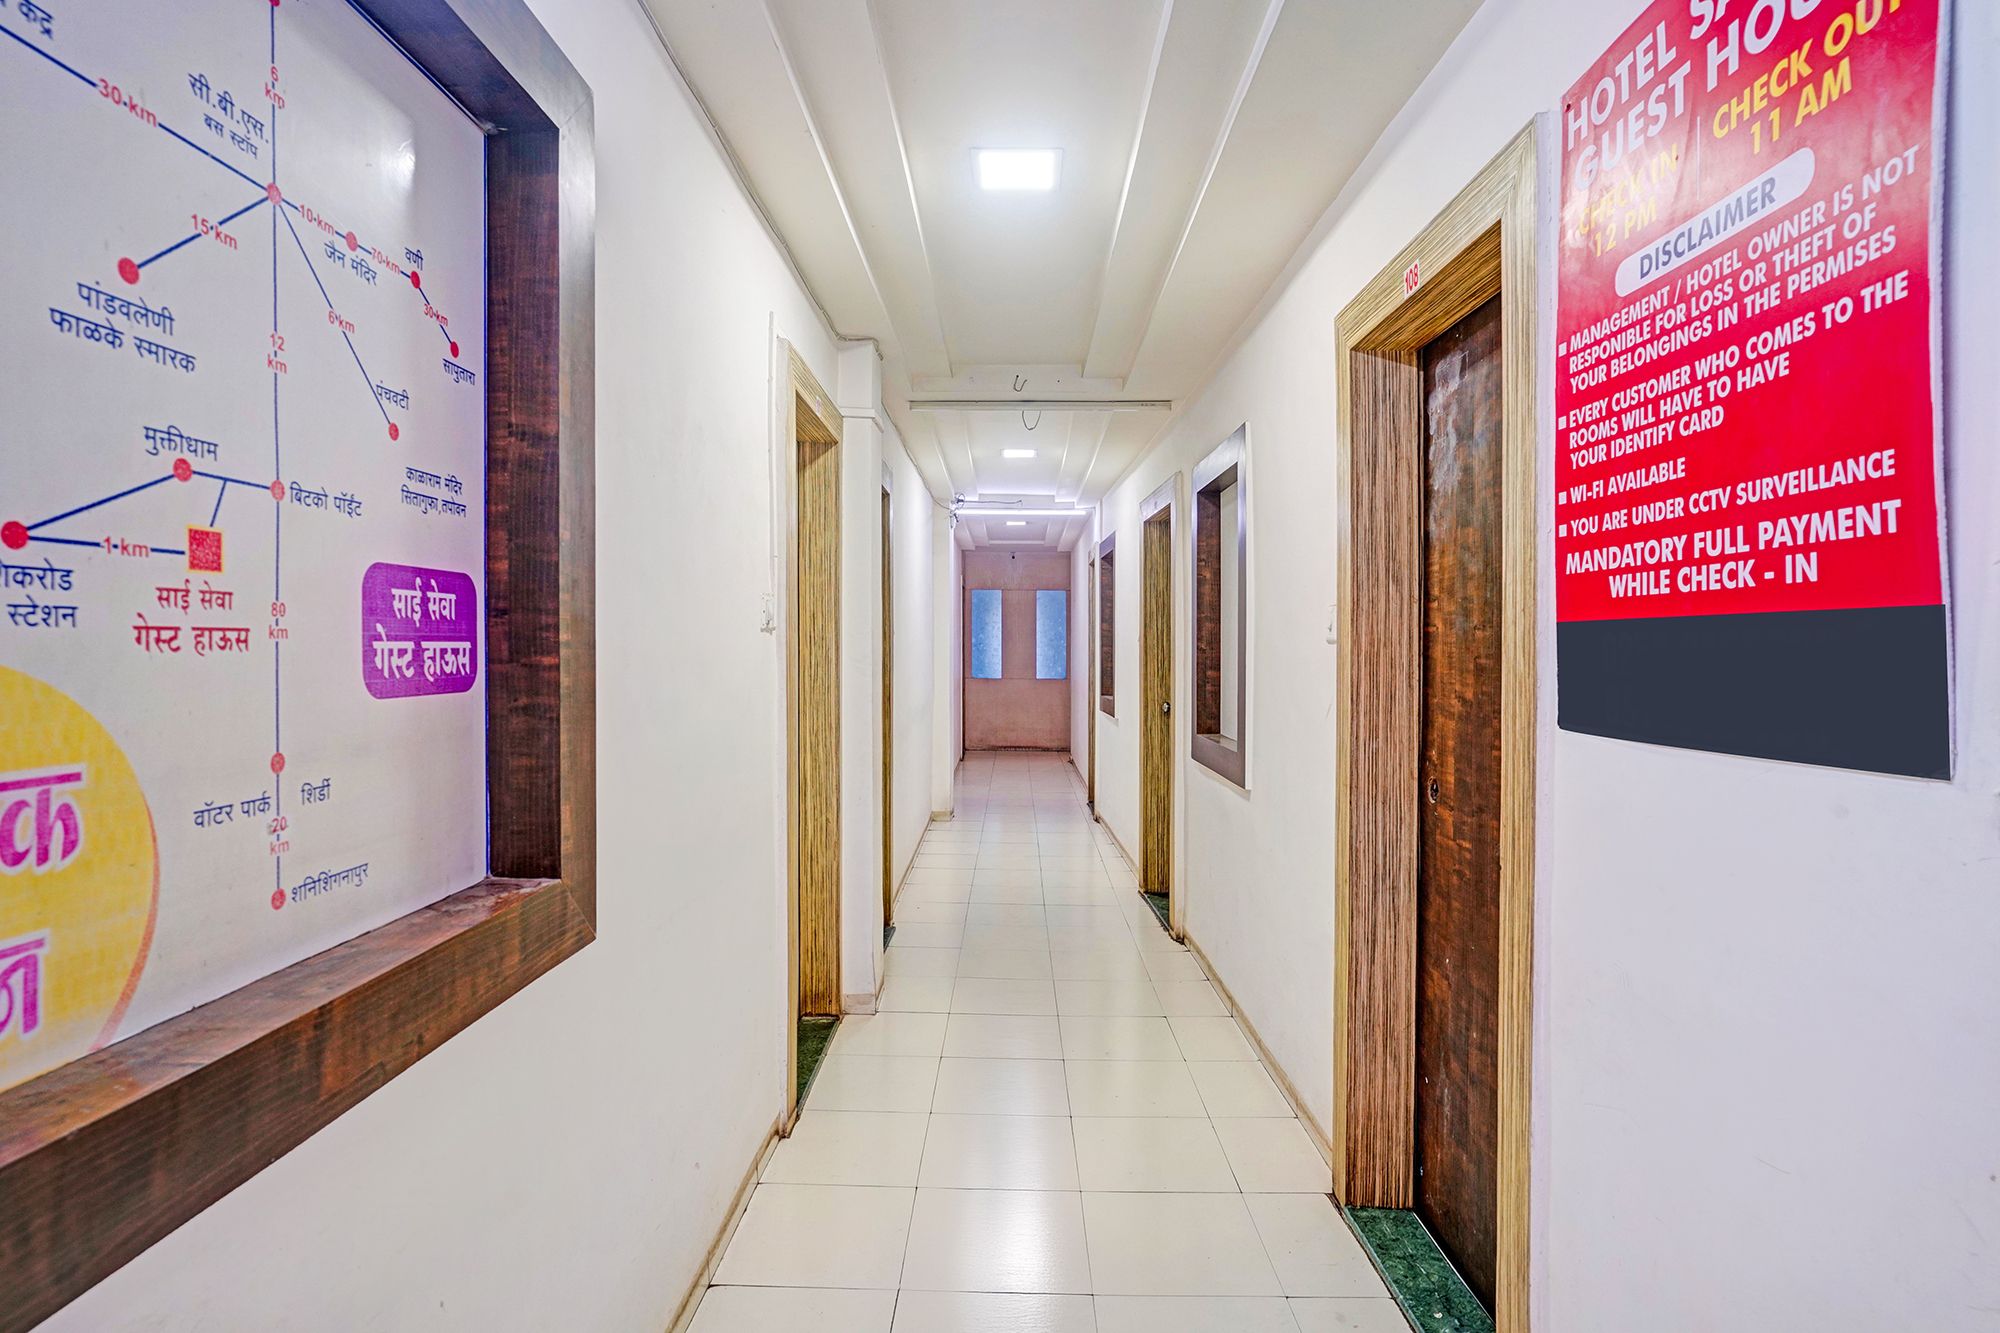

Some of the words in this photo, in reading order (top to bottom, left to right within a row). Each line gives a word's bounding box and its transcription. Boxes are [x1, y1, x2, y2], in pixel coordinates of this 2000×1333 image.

[265, 82, 284, 109] km
[1567, 21, 1676, 152] HOTEL
[1714, 38, 1813, 138] CHECK
[1751, 108, 1780, 154] 11
[1795, 56, 1852, 128] AM
[203, 113, 224, 137] बस
[229, 130, 258, 159] स्टॉप
[1574, 57, 1690, 191] GUEST
[1570, 286, 1670, 352] MANAGEMENT
[1687, 248, 1742, 294] HOTEL
[1748, 201, 1825, 259] OWNER
[1834, 184, 1853, 216] IS
[1863, 144, 1918, 200] NOT
[1595, 223, 1616, 257] 12
[1624, 195, 1656, 240] PM
[1640, 177, 1776, 280] DISCLAIMER
[350, 255, 377, 286] मंदिर
[1405, 263, 1419, 294] 108
[1570, 320, 1650, 374] RESPONIBLE
[1656, 303, 1686, 334] FOR
[1692, 279, 1733, 317] LOSS
[1740, 262, 1766, 292] OR
[1773, 224, 1836, 276] THEFT
[1844, 202, 1876, 239] OF
[77, 281, 175, 336] पांडवलेणी
[1570, 364, 1607, 394] YOUR
[1611, 316, 1712, 378] BELONGINGS
[1718, 302, 1738, 331] IN
[1744, 282, 1780, 318] THE
[1788, 225, 1896, 299] PERMISES
[49, 307, 124, 350] फाळके
[133, 336, 196, 373] स्मारक
[267, 353, 287, 374] km
[1570, 398, 1608, 428] EVERY
[1612, 365, 1690, 411] CUSTOMER
[1695, 345, 1739, 380] WHO
[1746, 312, 1816, 359] COMES
[1822, 296, 1853, 329] TO
[1860, 270, 1908, 313] THE
[376, 380, 409, 410] पंचवटी
[1570, 417, 1618, 449] ROOMS
[1622, 404, 1655, 431] WILL
[1660, 386, 1702, 418] HAVE
[1707, 376, 1731, 402] TO
[1738, 352, 1789, 392] HAVE
[143, 425, 218, 461] मुक्तीधाम
[1570, 444, 1606, 470] YOUR
[1611, 420, 1675, 458] IDENTIFY
[1680, 406, 1724, 436] CARD
[290, 481, 328, 510] बिटको
[444, 473, 463, 496] मंदिर
[1570, 480, 1603, 504] WI-FI
[1608, 457, 1686, 495] AVAILABLE
[1570, 515, 1598, 536] YOU
[1602, 509, 1627, 531] ARE
[1632, 497, 1684, 525] UNDER
[1689, 486, 1731, 514] CCTV
[1736, 448, 1895, 505] SURVEILLANCE
[1566, 534, 1687, 574] MANDATORY
[1694, 525, 1750, 558] FULL
[1758, 499, 1901, 550] PAYMENT
[155, 578, 190, 615] साई
[198, 579, 234, 610] सेवा
[1609, 569, 1670, 598] WHILE
[1678, 559, 1756, 592] CHECK
[1786, 552, 1818, 584] IN
[6, 594, 78, 628] स्टेशन
[271, 602, 286, 618] 80
[391, 576, 422, 628] साई
[427, 578, 457, 621] सेवा
[132, 612, 181, 653] गेस्ट
[191, 626, 250, 657] हाऊस
[268, 625, 288, 641] km
[372, 622, 415, 679] गेस्ट
[421, 641, 471, 682] हाऊस
[193, 801, 234, 828] वॉटर
[241, 790, 271, 817] पार्क
[272, 816, 287, 834] 20
[270, 841, 289, 856] km
